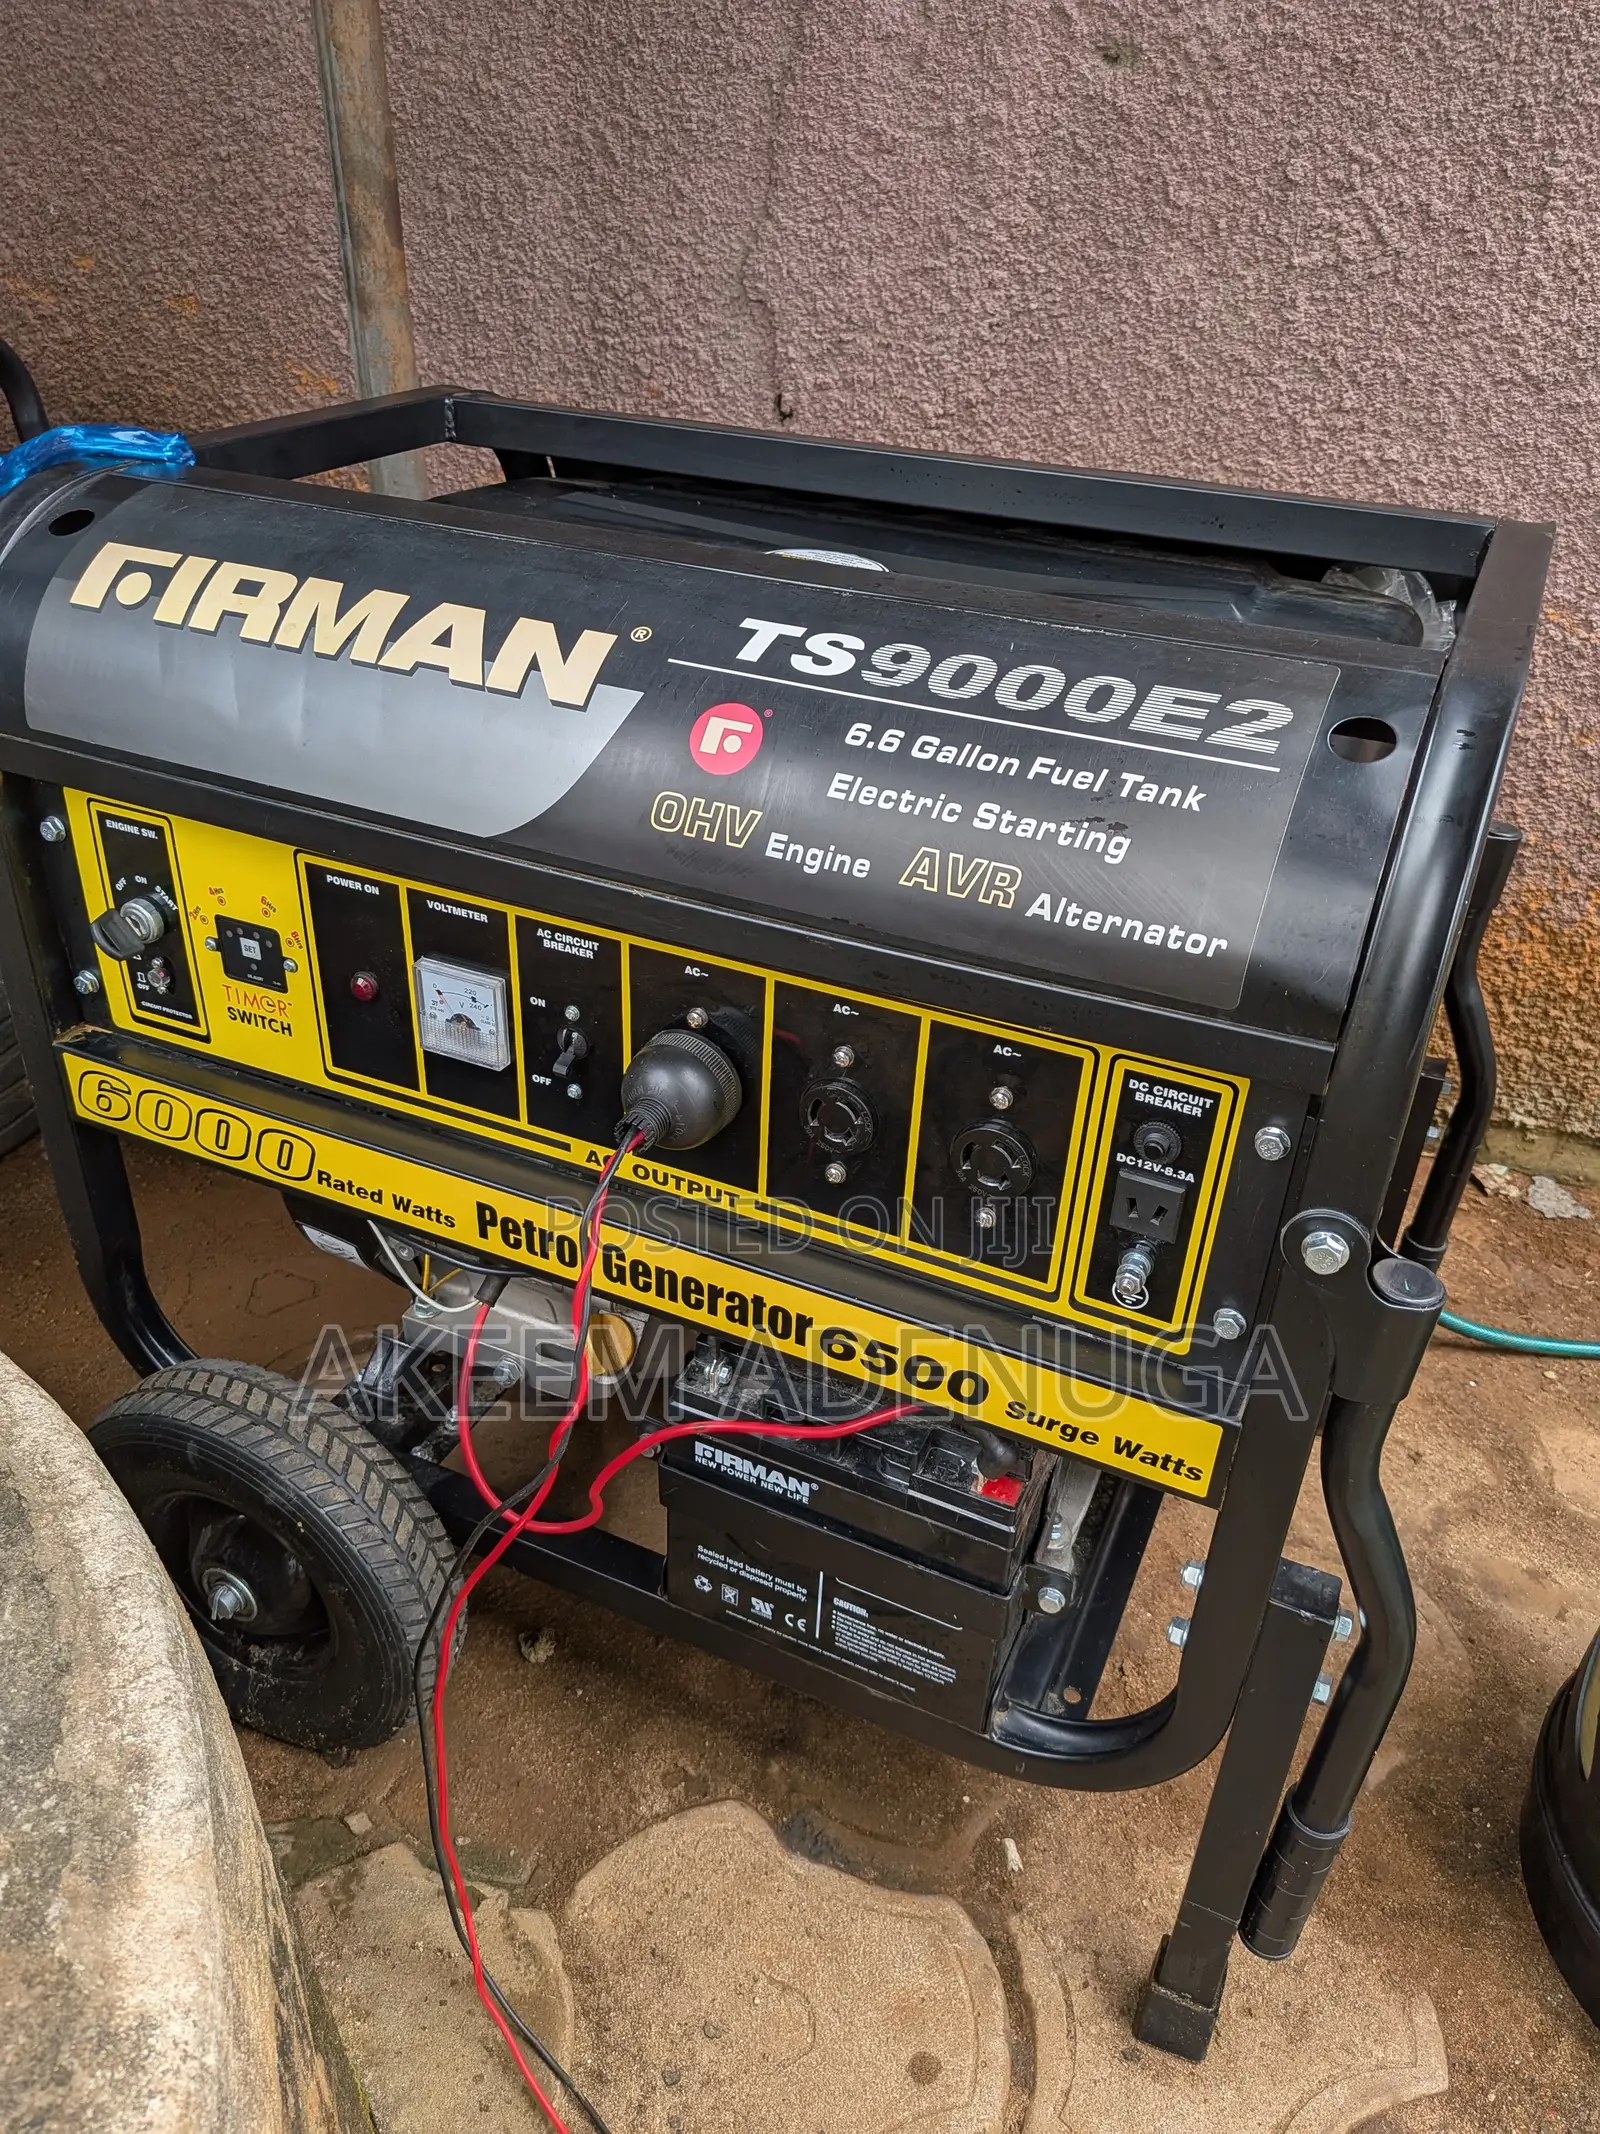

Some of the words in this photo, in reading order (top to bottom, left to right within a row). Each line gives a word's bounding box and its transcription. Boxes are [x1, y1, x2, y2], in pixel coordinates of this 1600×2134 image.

[70, 542, 617, 706] FIRMAN
[736, 617, 1293, 754] TS9000E2
[845, 723, 904, 754] 6.6
[912, 735, 1025, 779] Gallon
[1029, 757, 1106, 793] Fuel
[1119, 771, 1207, 811] Tank
[106, 819, 140, 835] ENGINE
[141, 827, 158, 839] SW.
[827, 772, 962, 822] Electric
[973, 802, 1131, 864] Starting
[115, 877, 127, 891] OFF
[135, 875, 147, 885] ON
[326, 874, 363, 894] POWER
[364, 884, 380, 896] ON
[650, 790, 762, 848] OHV
[766, 832, 872, 879] Engine
[899, 846, 1025, 909] AVR
[1025, 892, 1228, 957] Alternator
[154, 885, 178, 912] START
[427, 900, 489, 923] VOLTMETER
[244, 944, 257, 954] SET
[536, 928, 552, 941] AC
[554, 933, 600, 953] CIRCUIT
[543, 937, 594, 960] BREAKER
[529, 997, 546, 1008] ON
[228, 1007, 293, 1037] SWITCH
[532, 1074, 552, 1087] OFF
[1129, 1079, 1150, 1095] DC
[1152, 1085, 1214, 1110] CIRCUIT
[1134, 1091, 1203, 1118] BREAKER
[1116, 1153, 1195, 1184] DC12V-8.3A
[633, 1163, 740, 1208] OUTPUT
[78, 1070, 316, 1181] 6000
[317, 1169, 383, 1205] Rated
[391, 1194, 456, 1229] Watts
[476, 1201, 579, 1269] Petro
[602, 1243, 813, 1347] Generator
[819, 1329, 990, 1406] 6500
[1005, 1402, 1100, 1446] Surge
[1113, 1436, 1204, 1482] Watts
[695, 1441, 810, 1497] FIRMAN
[695, 1455, 717, 1469] NEW
[720, 1465, 757, 1484] POWER
[760, 1480, 783, 1494] NEW
[787, 1491, 809, 1505] LIFE
[697, 1545, 724, 1561] Sealed
[726, 1556, 744, 1569] lead
[745, 1563, 773, 1581] battery
[775, 1577, 796, 1590] must
[797, 1584, 808, 1595] be
[697, 1552, 728, 1570] recycled
[729, 1565, 738, 1574] or
[739, 1568, 773, 1588] disposed
